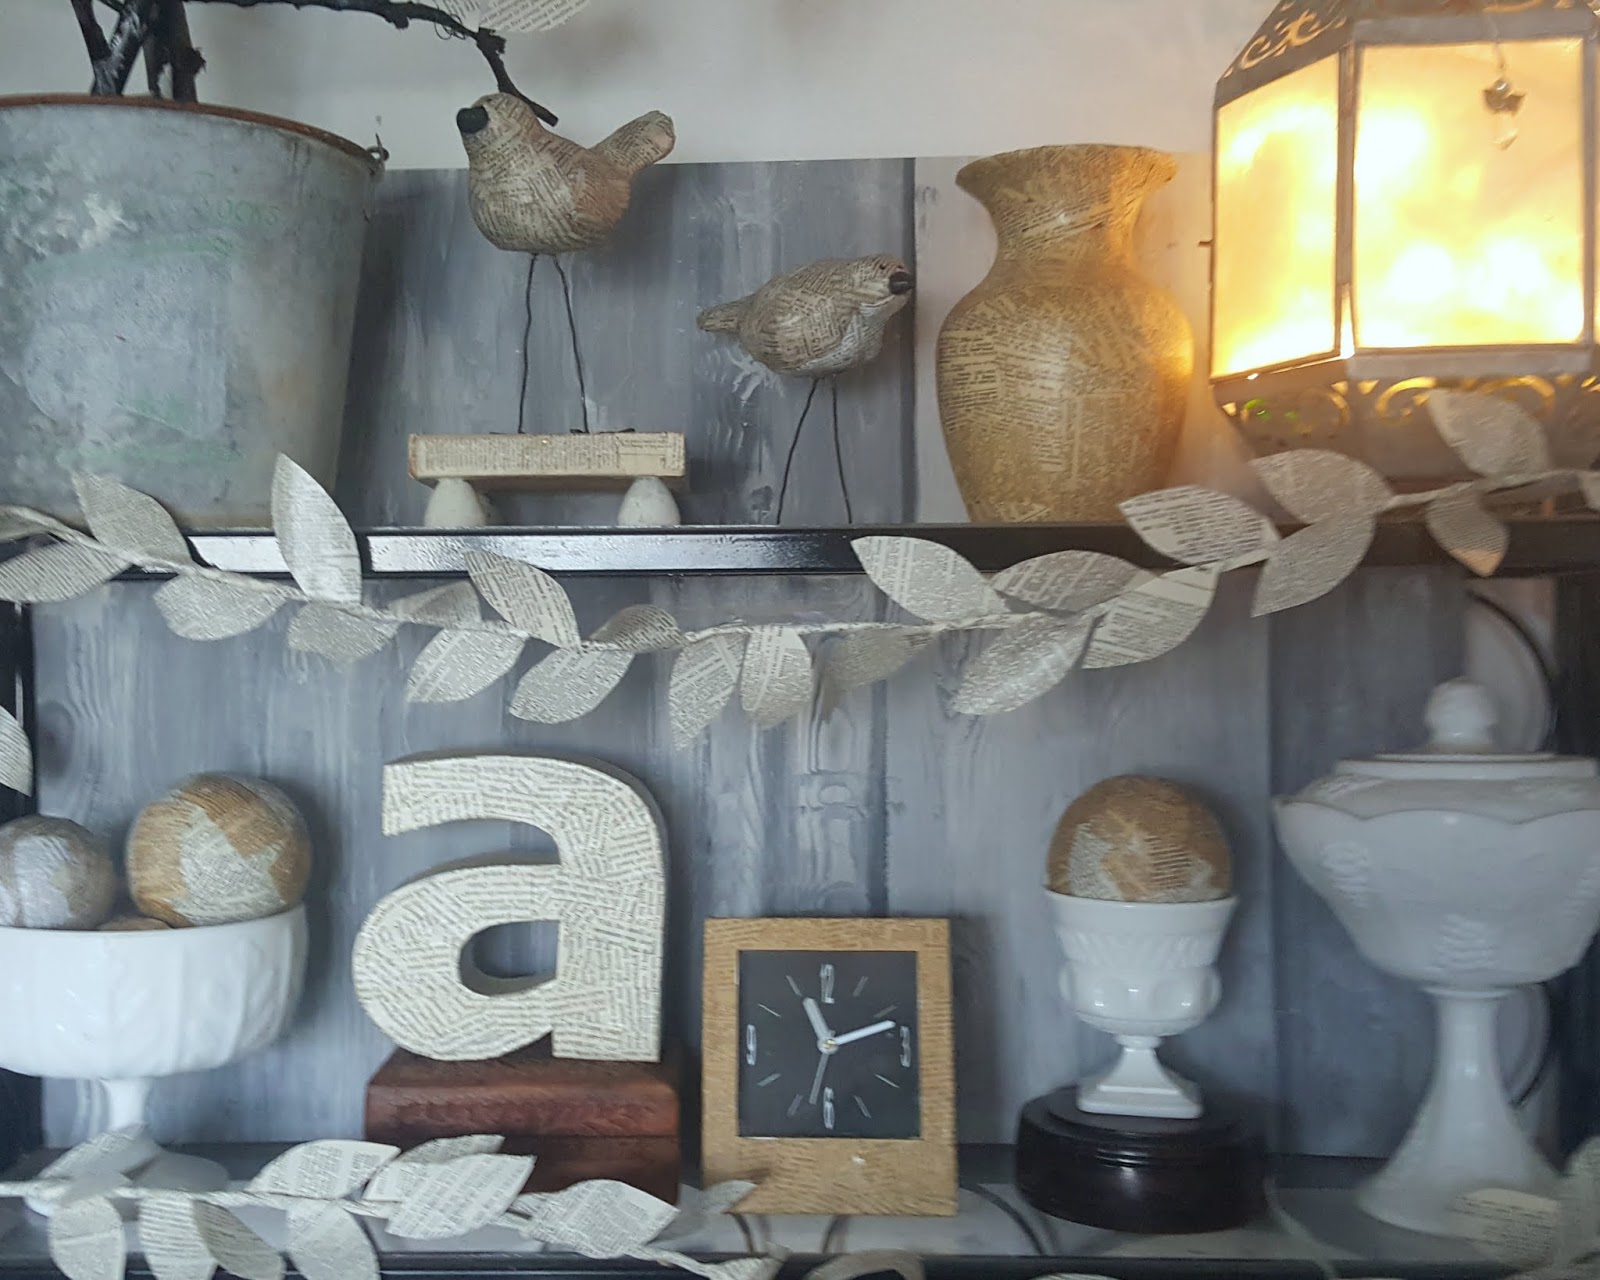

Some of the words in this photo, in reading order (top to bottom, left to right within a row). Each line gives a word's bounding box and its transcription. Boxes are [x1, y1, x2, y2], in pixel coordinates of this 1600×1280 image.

[352, 754, 665, 1062] a
[746, 1024, 757, 1066] 9
[900, 1025, 911, 1067] 3
[823, 1086, 834, 1129] 6
